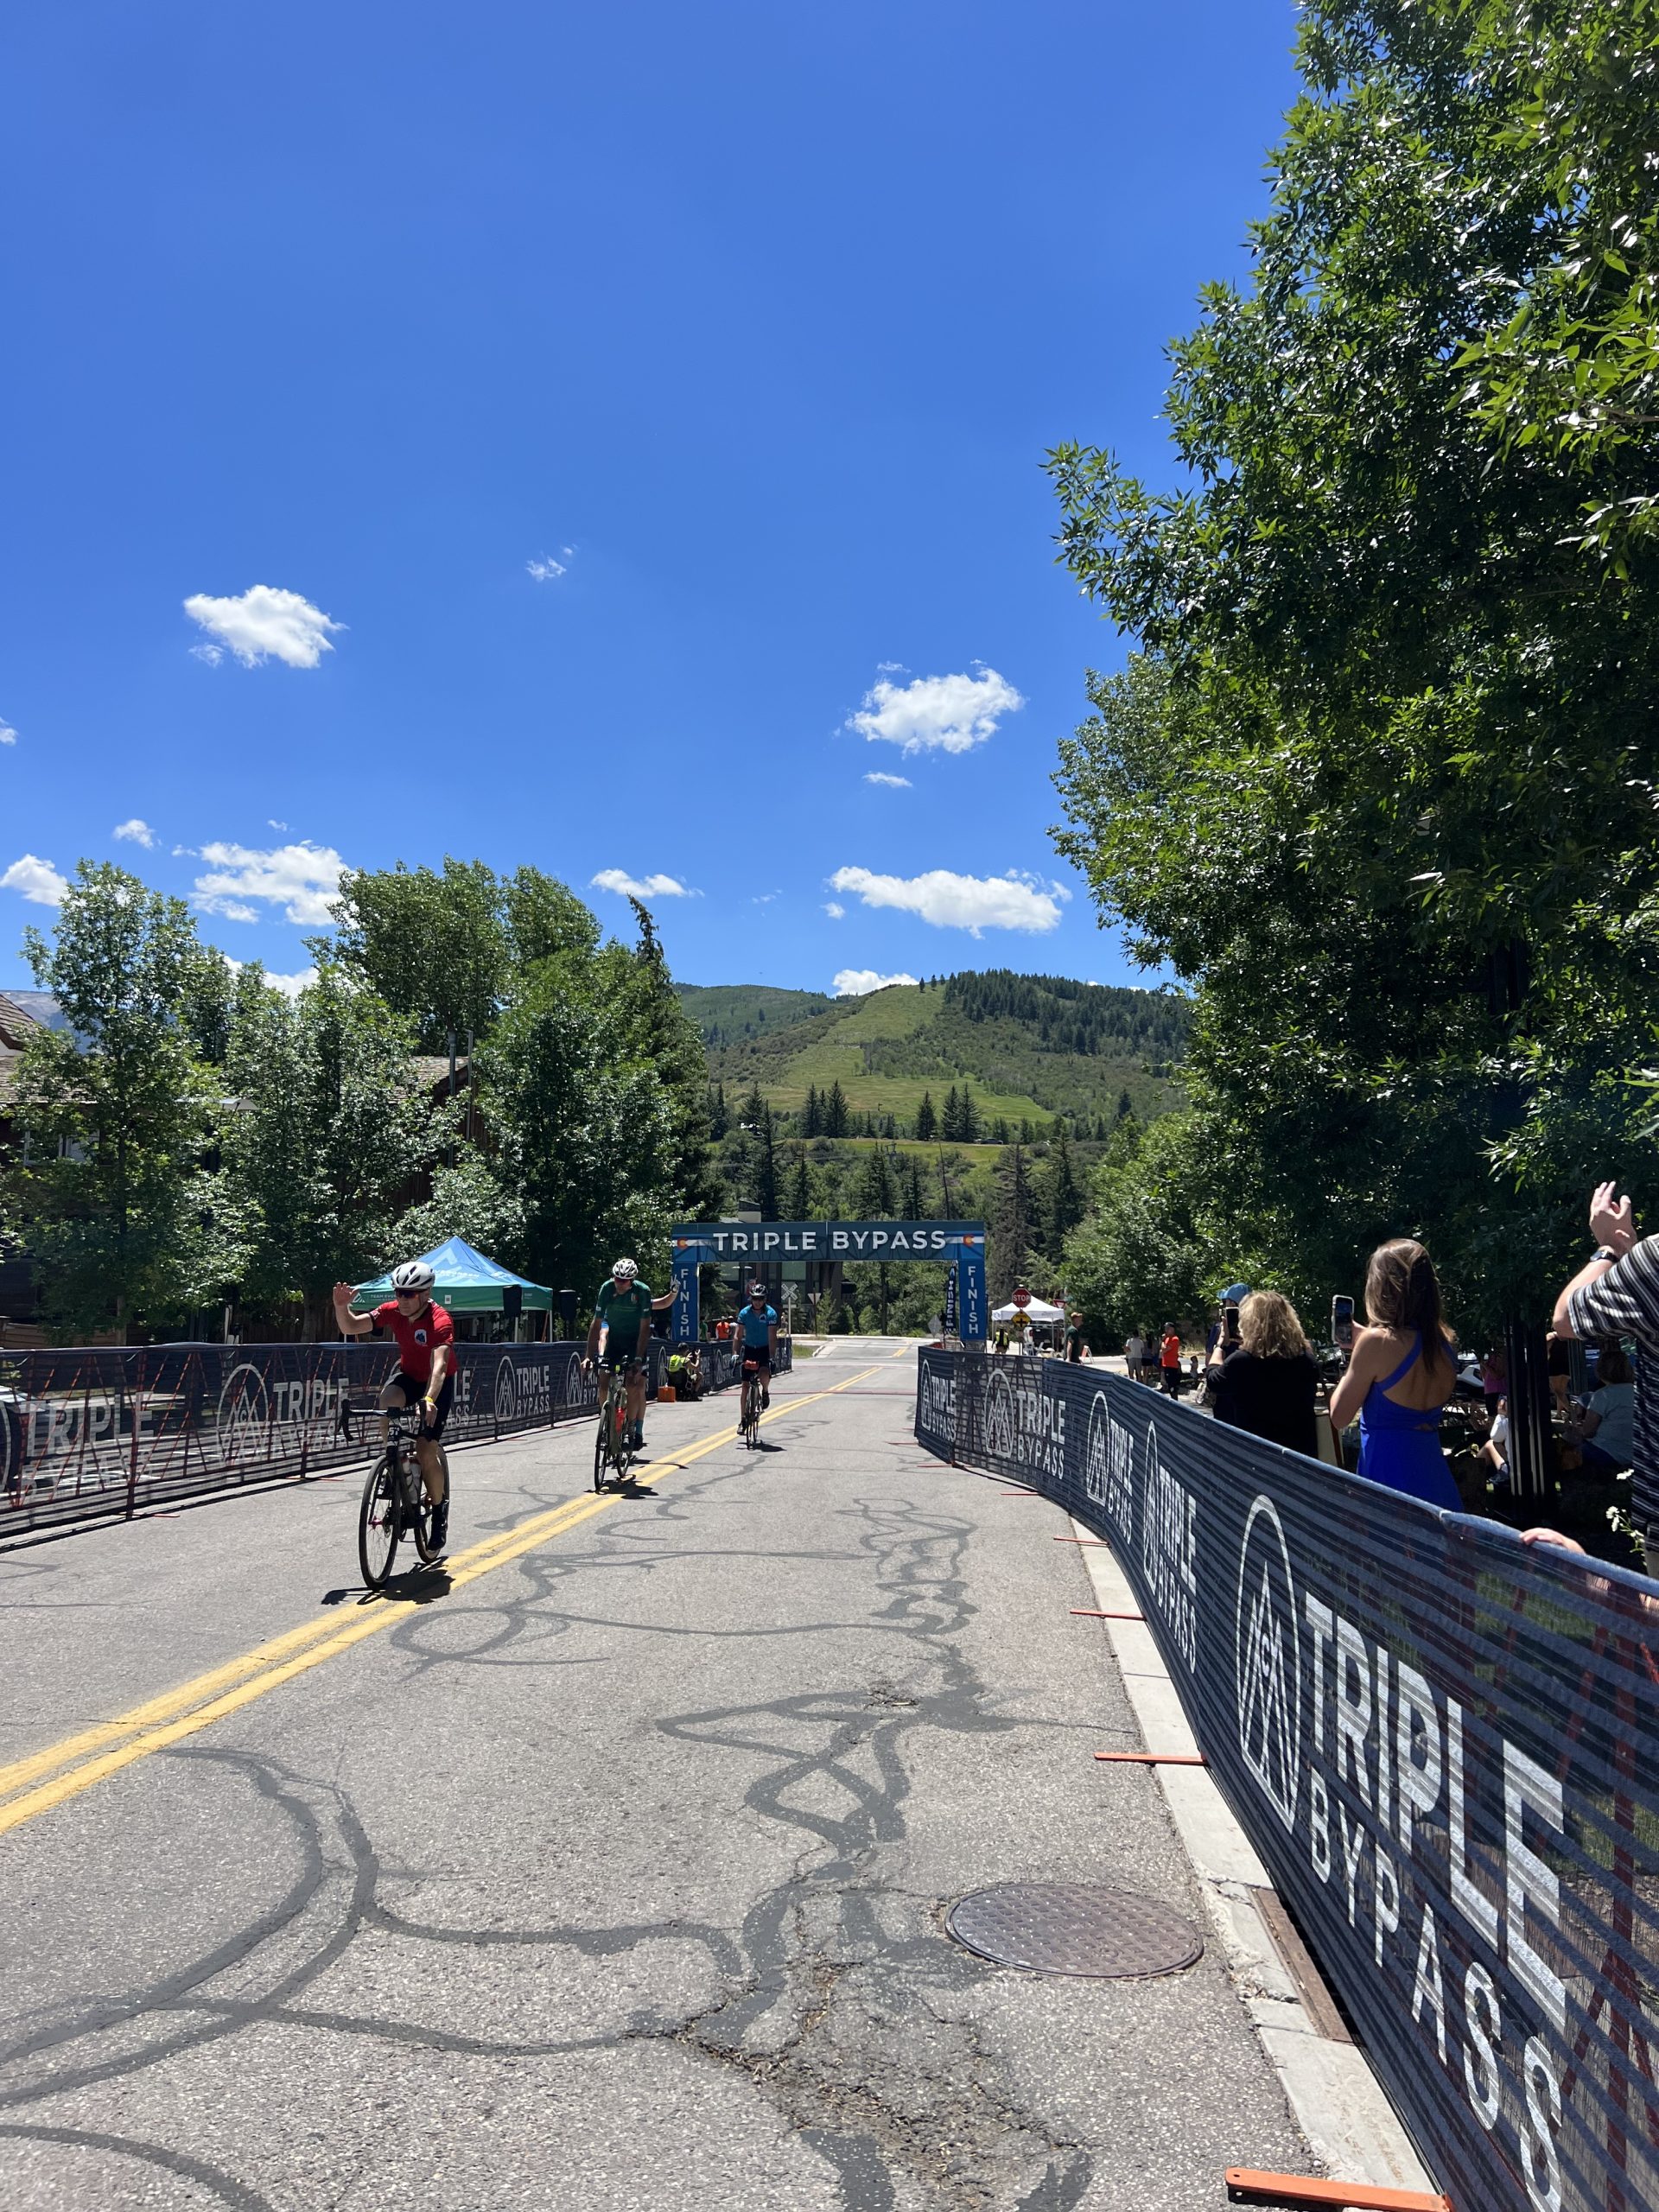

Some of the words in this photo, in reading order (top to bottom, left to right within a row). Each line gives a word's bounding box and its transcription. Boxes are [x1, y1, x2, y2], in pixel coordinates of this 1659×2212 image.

[713, 1231, 817, 1251] TRIPLE
[832, 1230, 947, 1249] BYPASS
[680, 1268, 690, 1337] FINISH
[968, 1266, 979, 1334] FINISH
[273, 1377, 349, 1422] TRIPLE
[516, 1365, 550, 1396] TRIPLE
[518, 1394, 550, 1418] BYPASS
[931, 1376, 957, 1415] TRIPLE
[19, 1391, 154, 1457] TRIPLE
[932, 1412, 957, 1442] BYPASS
[1016, 1390, 1065, 1445] TRIPLE
[1018, 1433, 1065, 1479] BYPASS
[1110, 1418, 1134, 1497] TRIPLE
[1108, 1478, 1132, 1545] BYPASS
[1160, 1465, 1197, 1597] TRIPLE
[1159, 1554, 1197, 1675] BYPASS
[1306, 1591, 1567, 2036] TRIPLE
[1311, 1767, 1562, 2212] BYPASS
